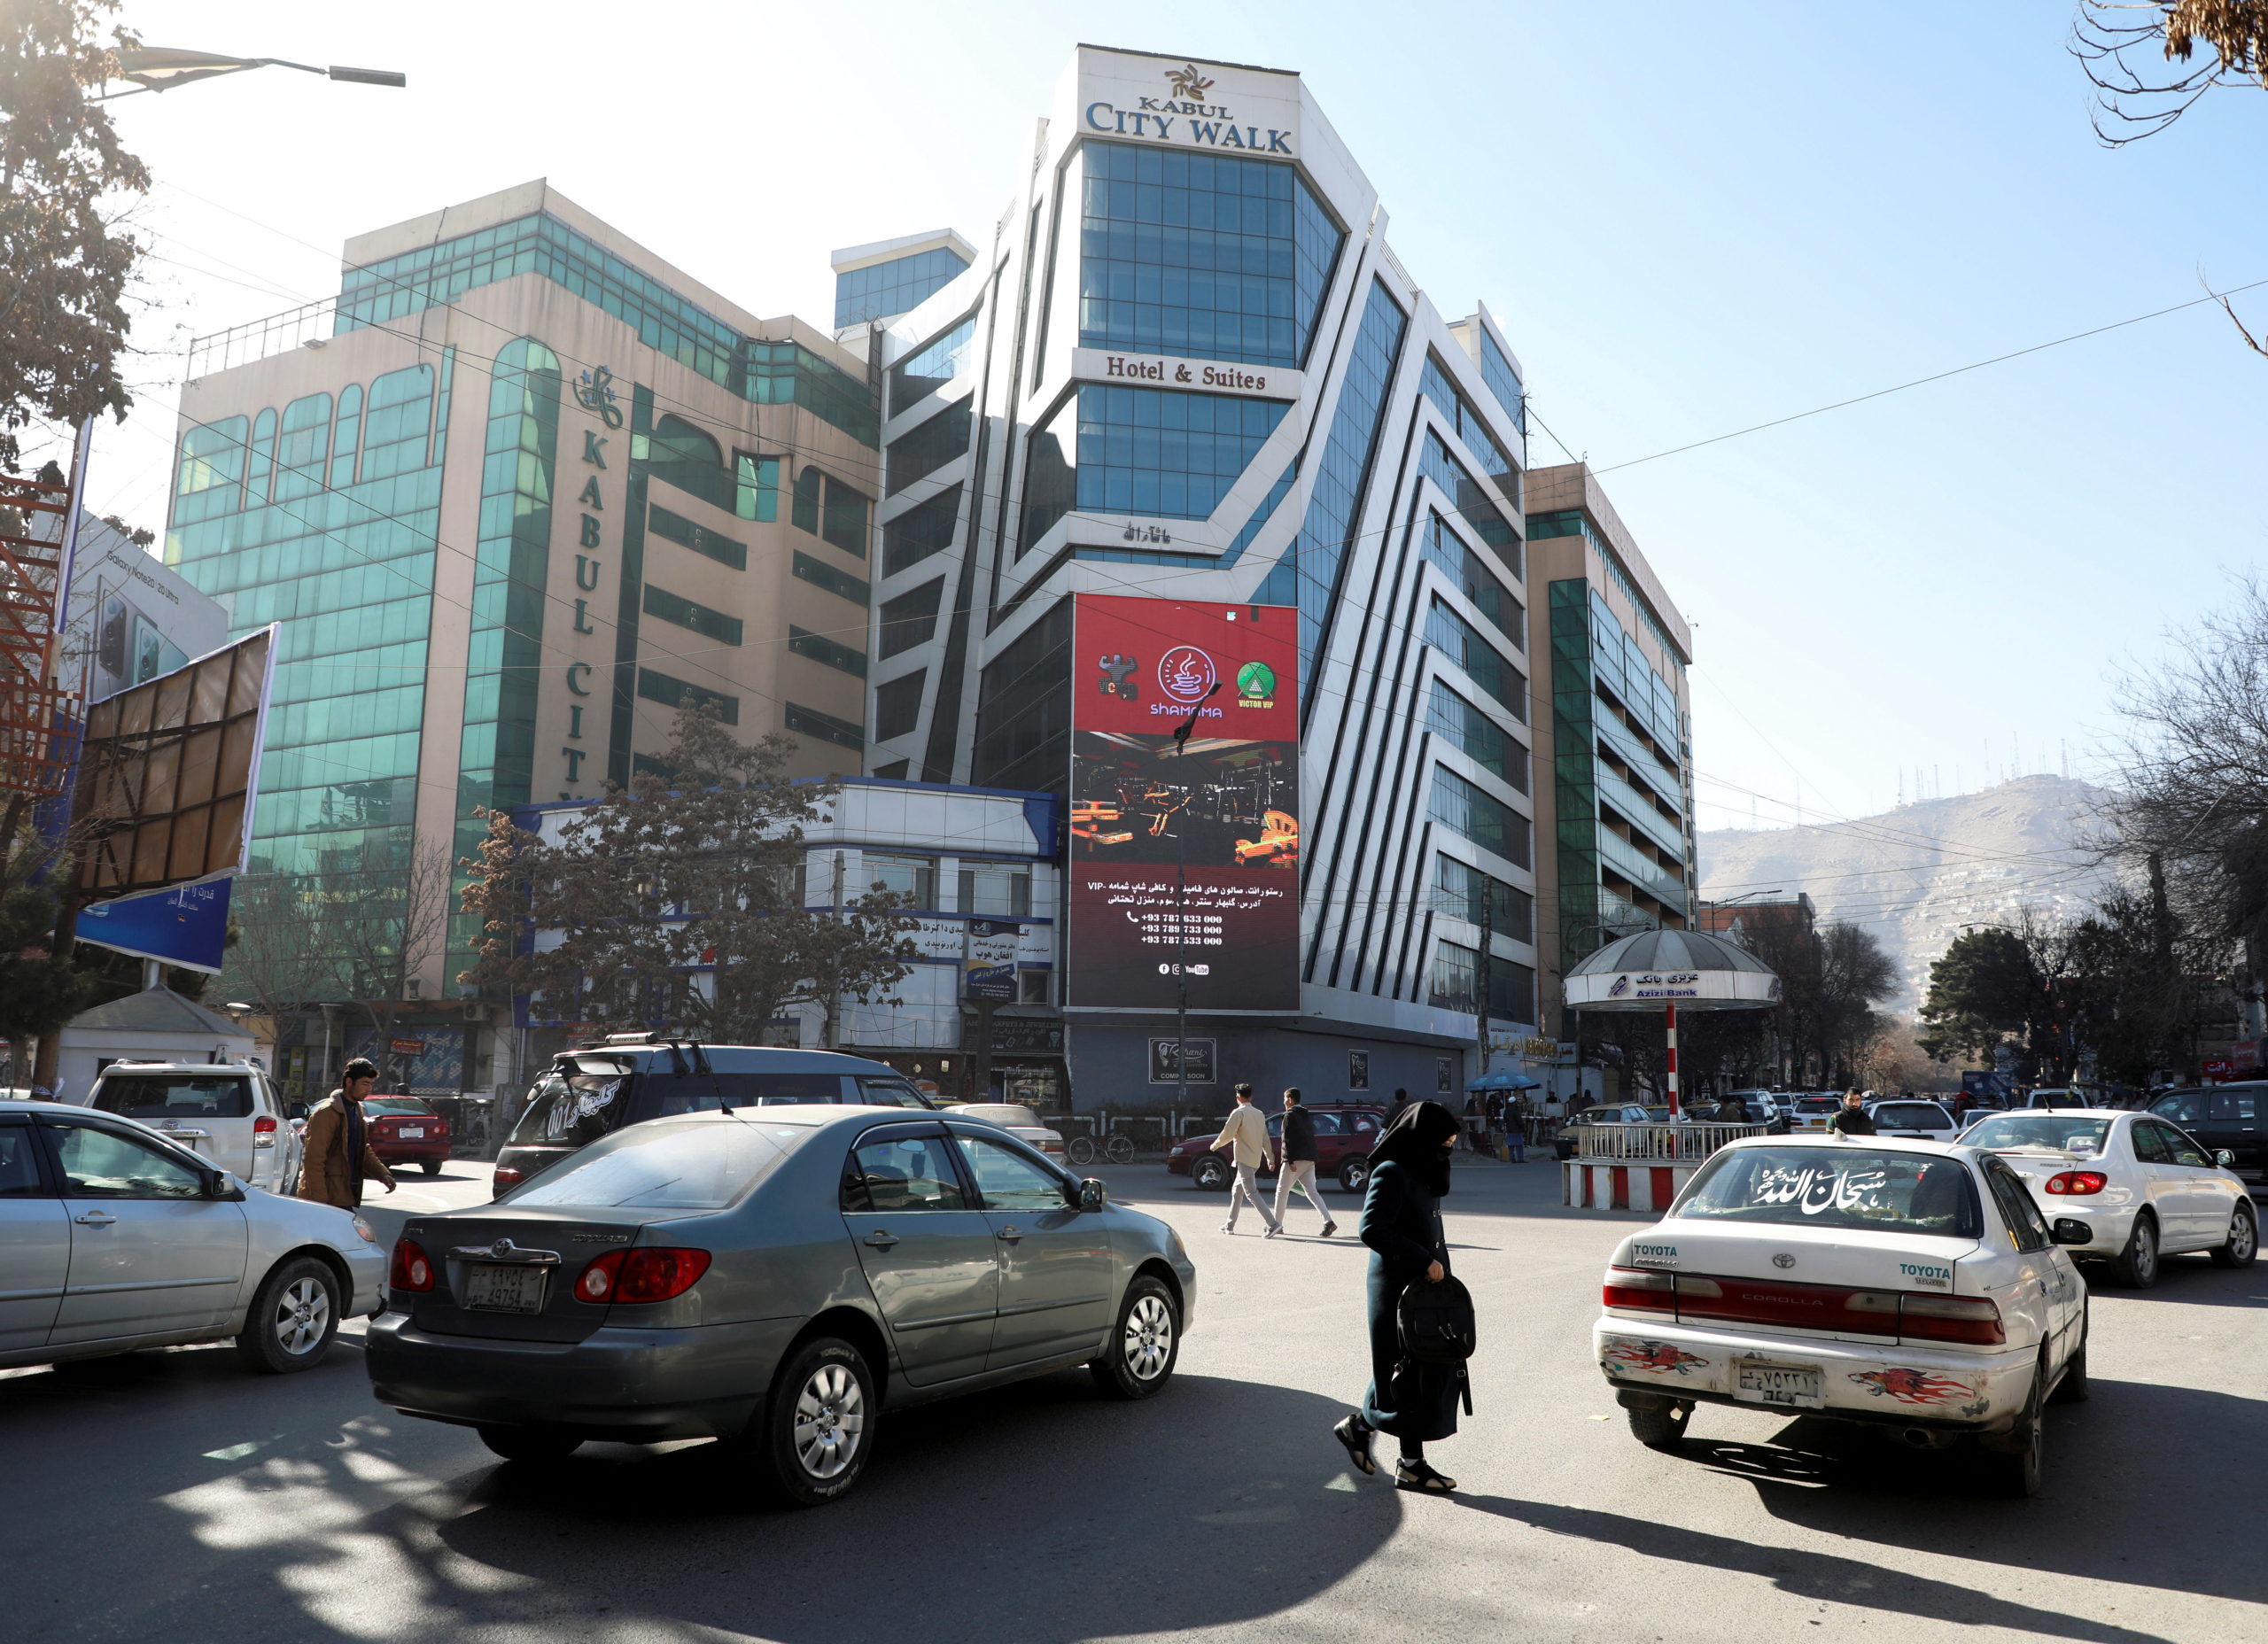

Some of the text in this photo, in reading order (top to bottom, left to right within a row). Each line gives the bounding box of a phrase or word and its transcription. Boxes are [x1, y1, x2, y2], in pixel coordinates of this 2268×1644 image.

[1139, 97, 1233, 120] KABUL
[1086, 102, 1293, 154] CITY WALK
[1107, 356, 1266, 391] Hotel & Suites
[107, 552, 132, 575] Galaxy
[131, 566, 155, 588] Note20
[557, 429, 609, 802] KABUL CIT
[1239, 699, 1262, 709] VICTOR
[1108, 880, 1130, 890] شمامه
[1131, 881, 1146, 894] شاپ
[1148, 882, 1167, 893] کافی
[1204, 885, 1218, 895] های
[1220, 886, 1243, 896] صالون
[1107, 894, 1134, 904] تحتانی
[1136, 896, 1155, 905] منزل
[1214, 898, 1236, 908] گلبهار
[993, 950, 1012, 960] افغان
[1636, 973, 1698, 985] عزیزی بانک
[548, 1102, 571, 1137] 001
[1634, 1245, 1677, 1257] TOYOTA
[1899, 1263, 1951, 1280] TOYOTA
[487, 1288, 522, 1306] 49754
[1743, 1292, 1824, 1307] COROLLA
